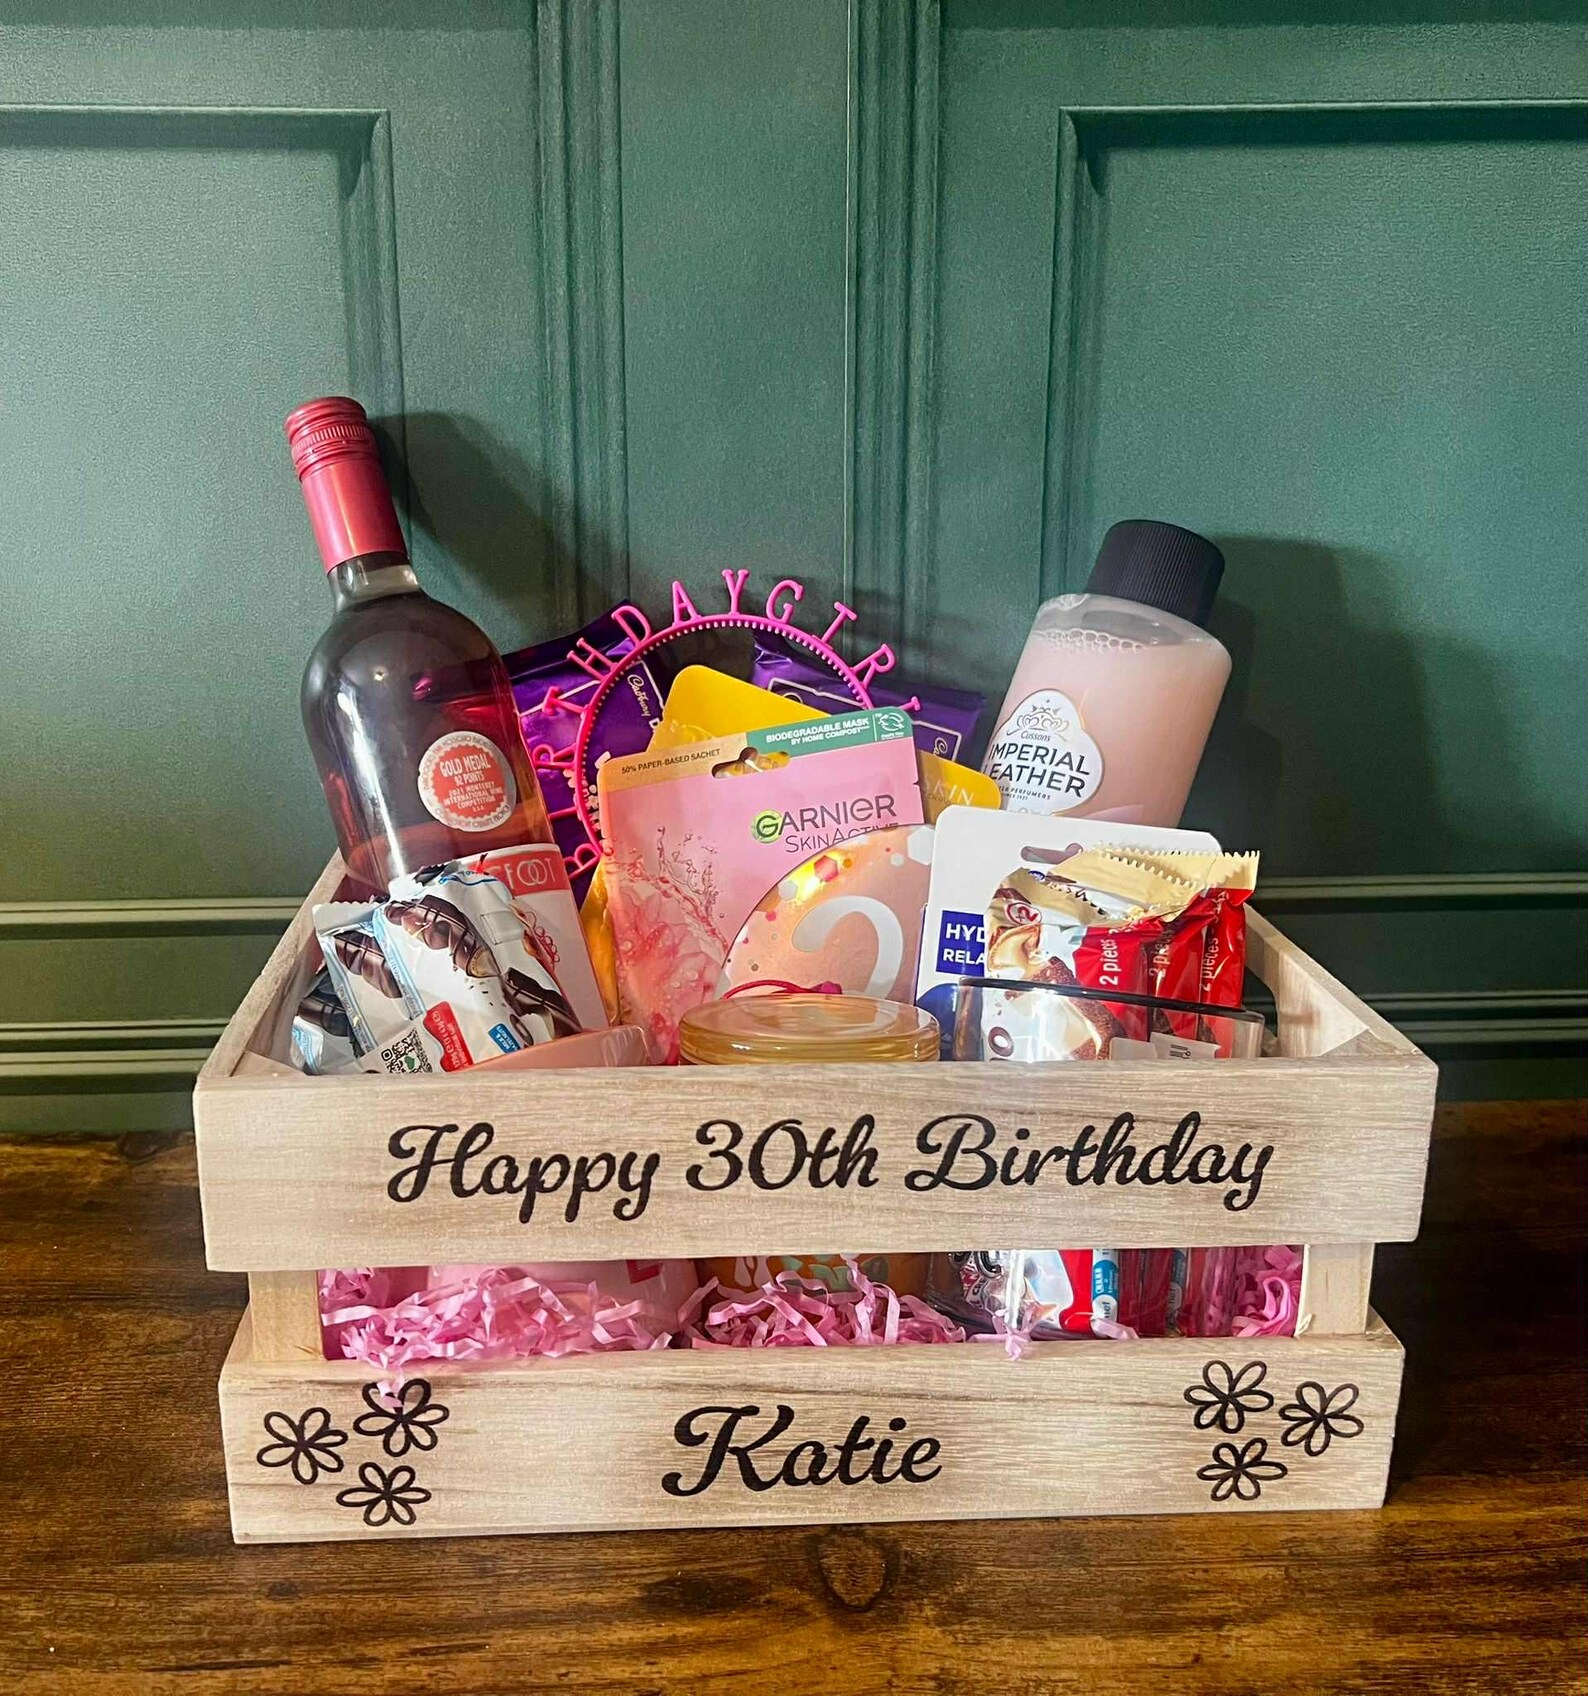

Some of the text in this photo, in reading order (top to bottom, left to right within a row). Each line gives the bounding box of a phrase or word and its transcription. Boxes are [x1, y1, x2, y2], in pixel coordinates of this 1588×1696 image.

[766, 721, 840, 743] BIODEGRADABLE
[842, 717, 869, 730] MASK
[790, 737, 801, 746] BY
[802, 732, 824, 744] HOME
[1020, 730, 1052, 743] Cussons
[440, 759, 463, 778] GOLD
[463, 752, 492, 773] MEDAL
[621, 748, 720, 775] 50% PAPER-BASED SACHET
[988, 742, 1091, 776] IMPERIAL
[463, 770, 485, 784] POINTS
[1010, 786, 1051, 800] PERFUMERS
[755, 793, 897, 840] GARNIER
[1099, 938, 1122, 986] 2 pieces
[1201, 937, 1220, 980] pieces
[387, 1111, 1274, 1223] Happy 30th Birthday
[661, 1404, 943, 1497] Katie
